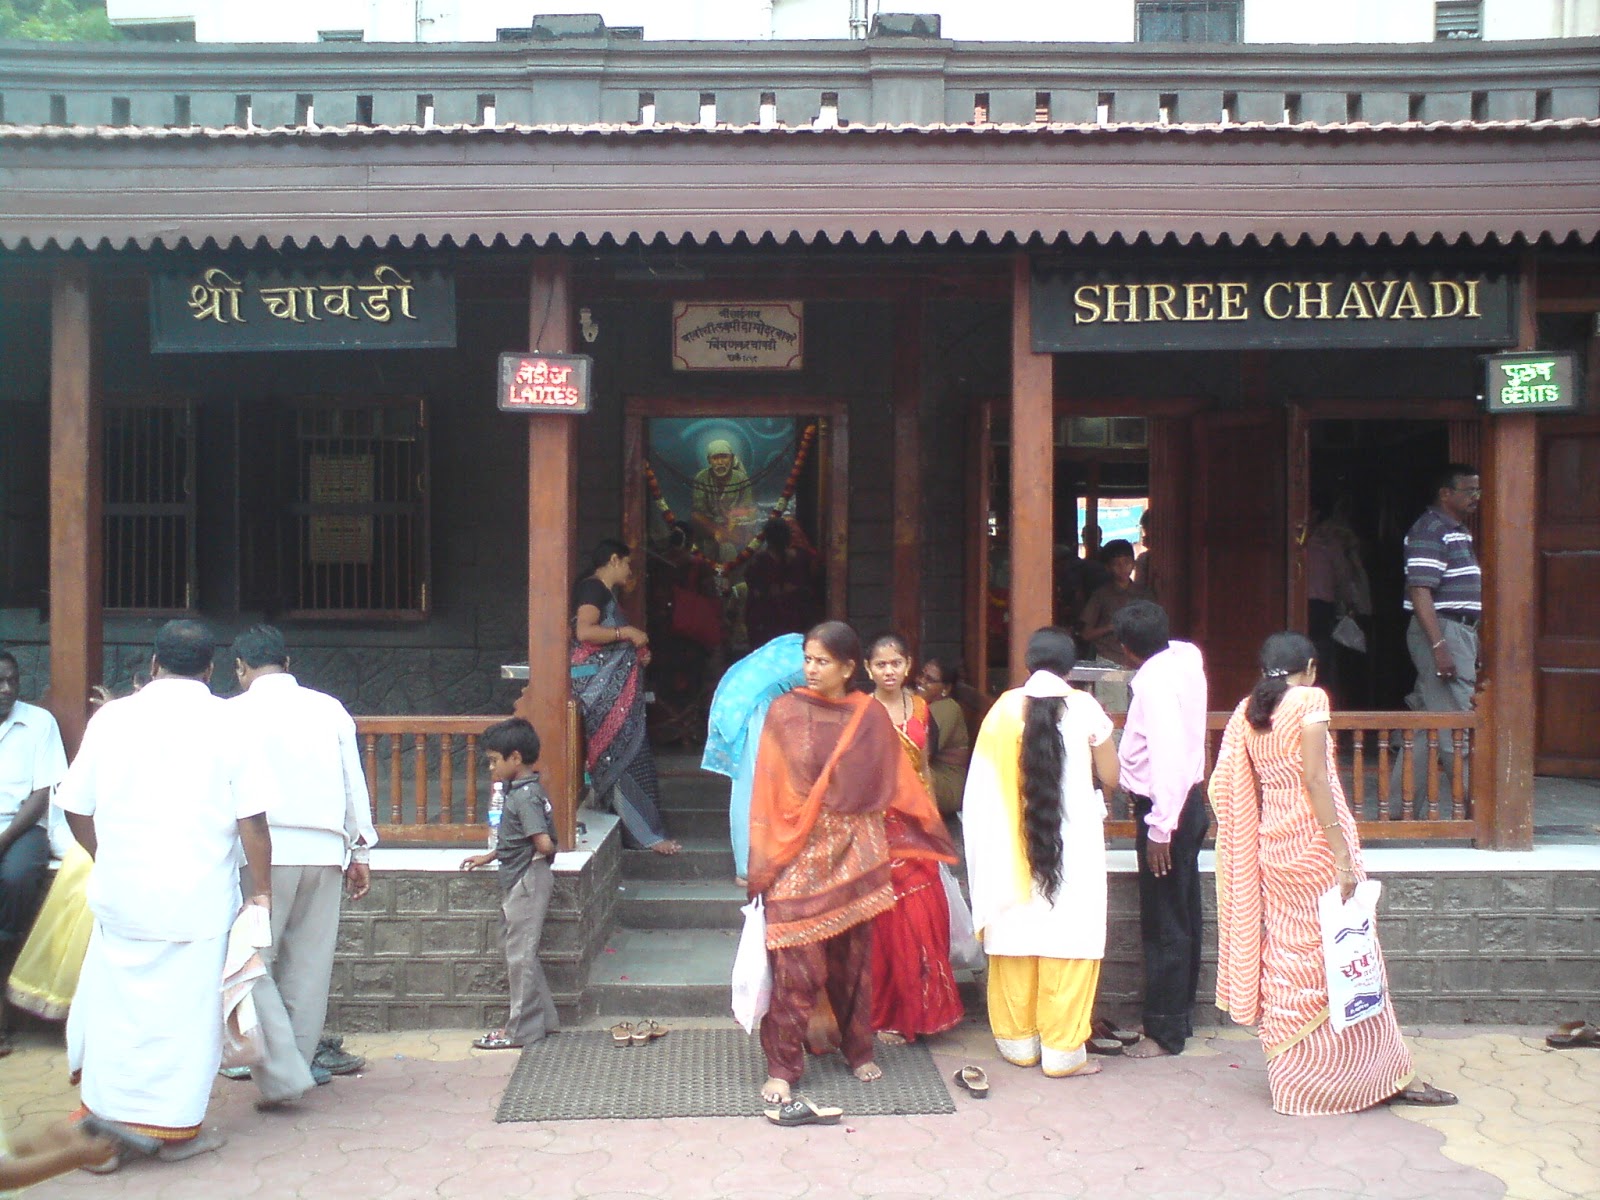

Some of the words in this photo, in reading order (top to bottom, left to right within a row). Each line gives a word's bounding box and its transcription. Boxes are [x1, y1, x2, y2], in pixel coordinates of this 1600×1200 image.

[187, 265, 247, 324] श्री
[259, 264, 417, 323] चावडी
[1073, 282, 1249, 325] SHREE
[1262, 279, 1483, 320] CHAVADI
[1500, 362, 1556, 387] पुरुष
[509, 385, 579, 406] LADIES
[1501, 384, 1559, 405] GENTS
